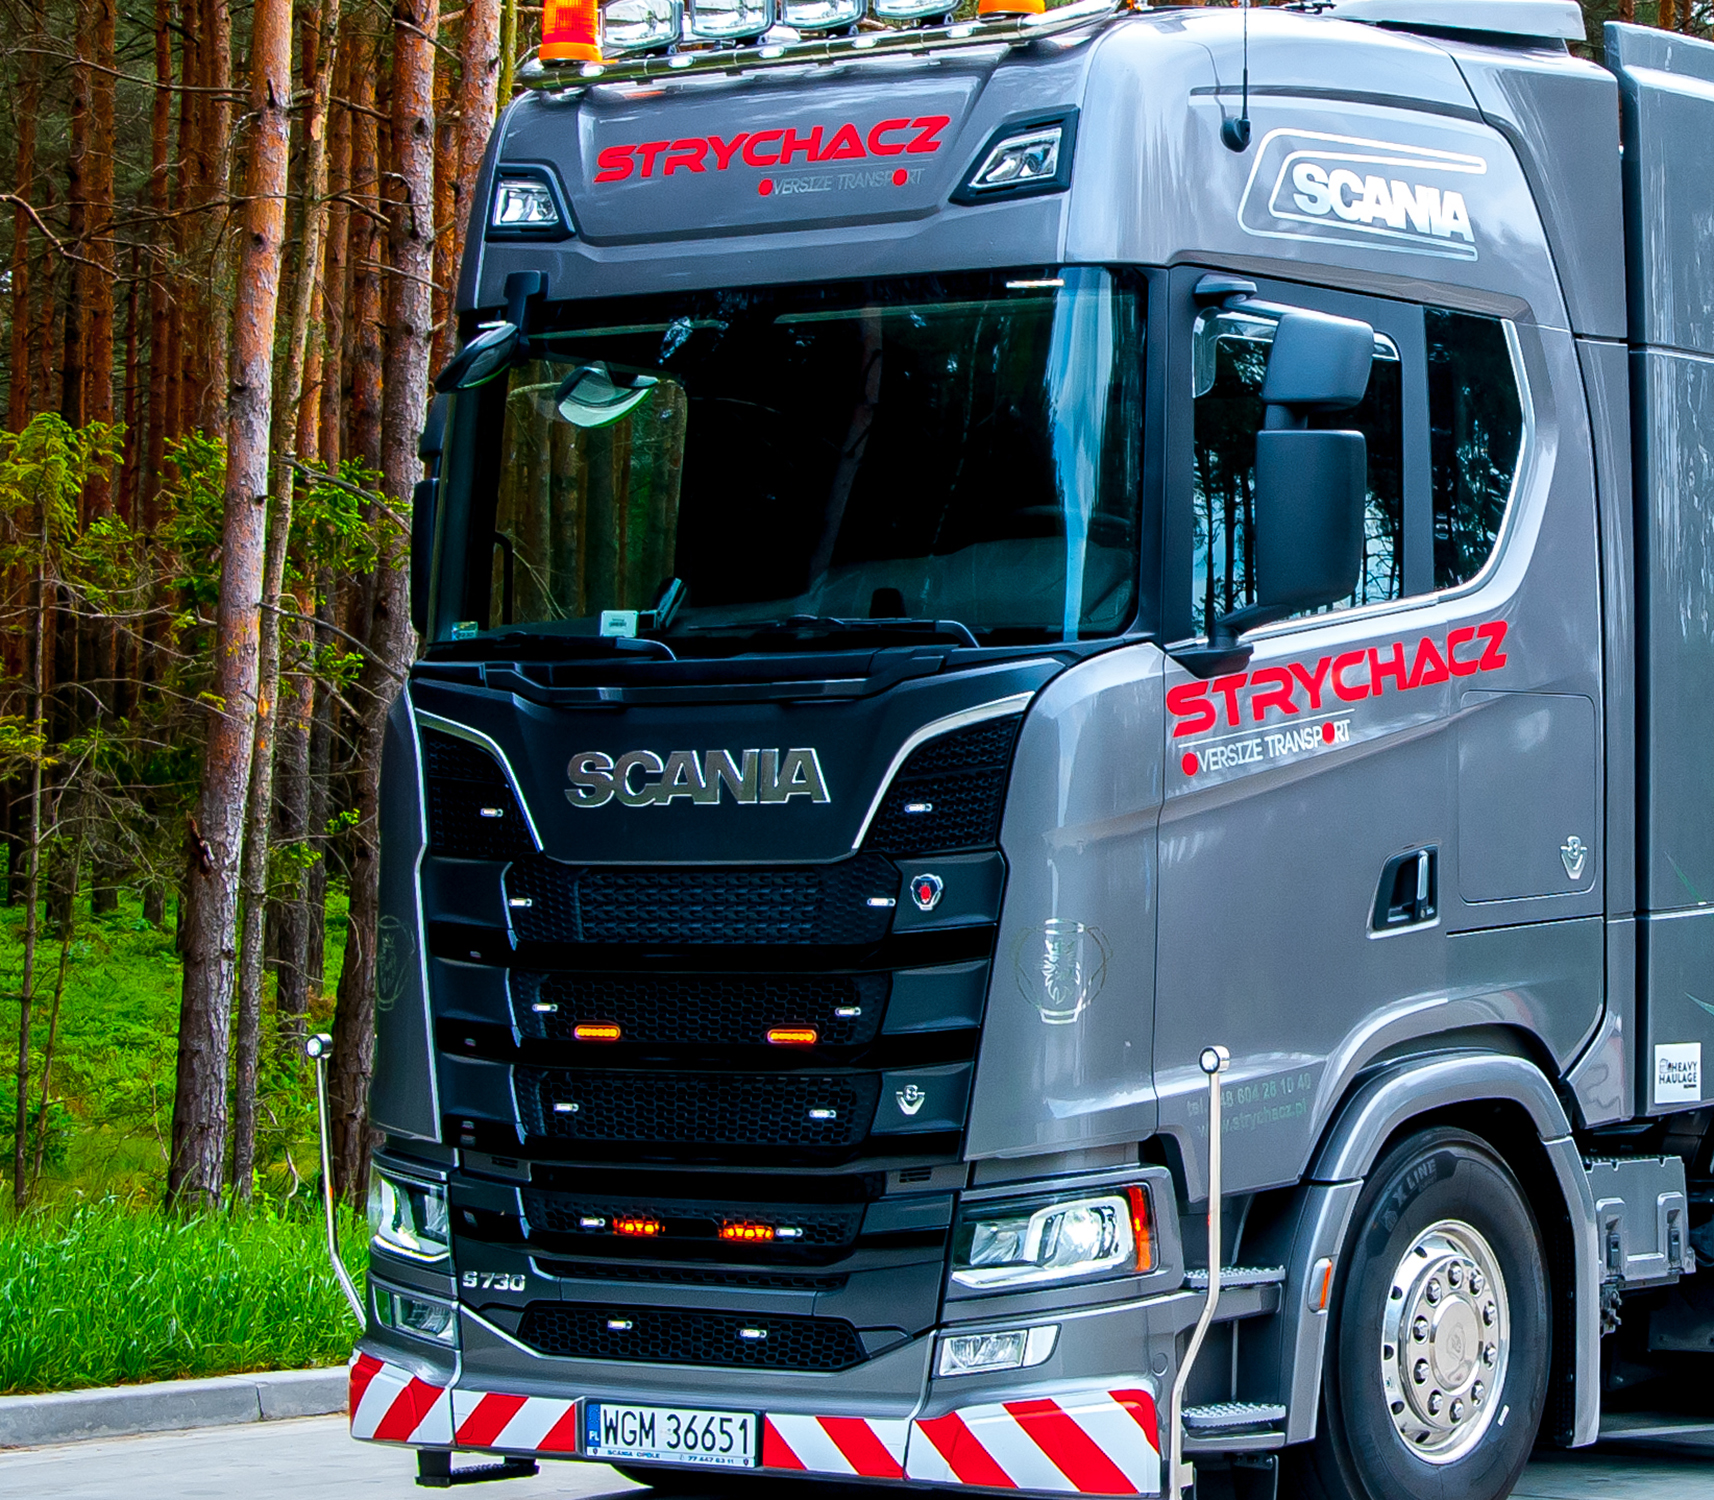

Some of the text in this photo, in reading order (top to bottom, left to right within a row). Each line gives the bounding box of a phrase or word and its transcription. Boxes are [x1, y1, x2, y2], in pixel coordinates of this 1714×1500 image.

[594, 115, 951, 184] STRYCHACZ
[1292, 162, 1476, 243] SCANIA
[1165, 620, 1509, 739] STRYCHACZ
[564, 747, 832, 808] SCANIA
[1659, 1071, 1698, 1085] HAULAGE
[1671, 1061, 1698, 1073] HEAVY
[1197, 1097, 1307, 1138] ww.strychacz.pl
[1406, 1158, 1437, 1190] LINE
[588, 1429, 600, 1442] PL
[603, 1409, 748, 1455] WGM 36651
[607, 1449, 633, 1458] SCANIA
